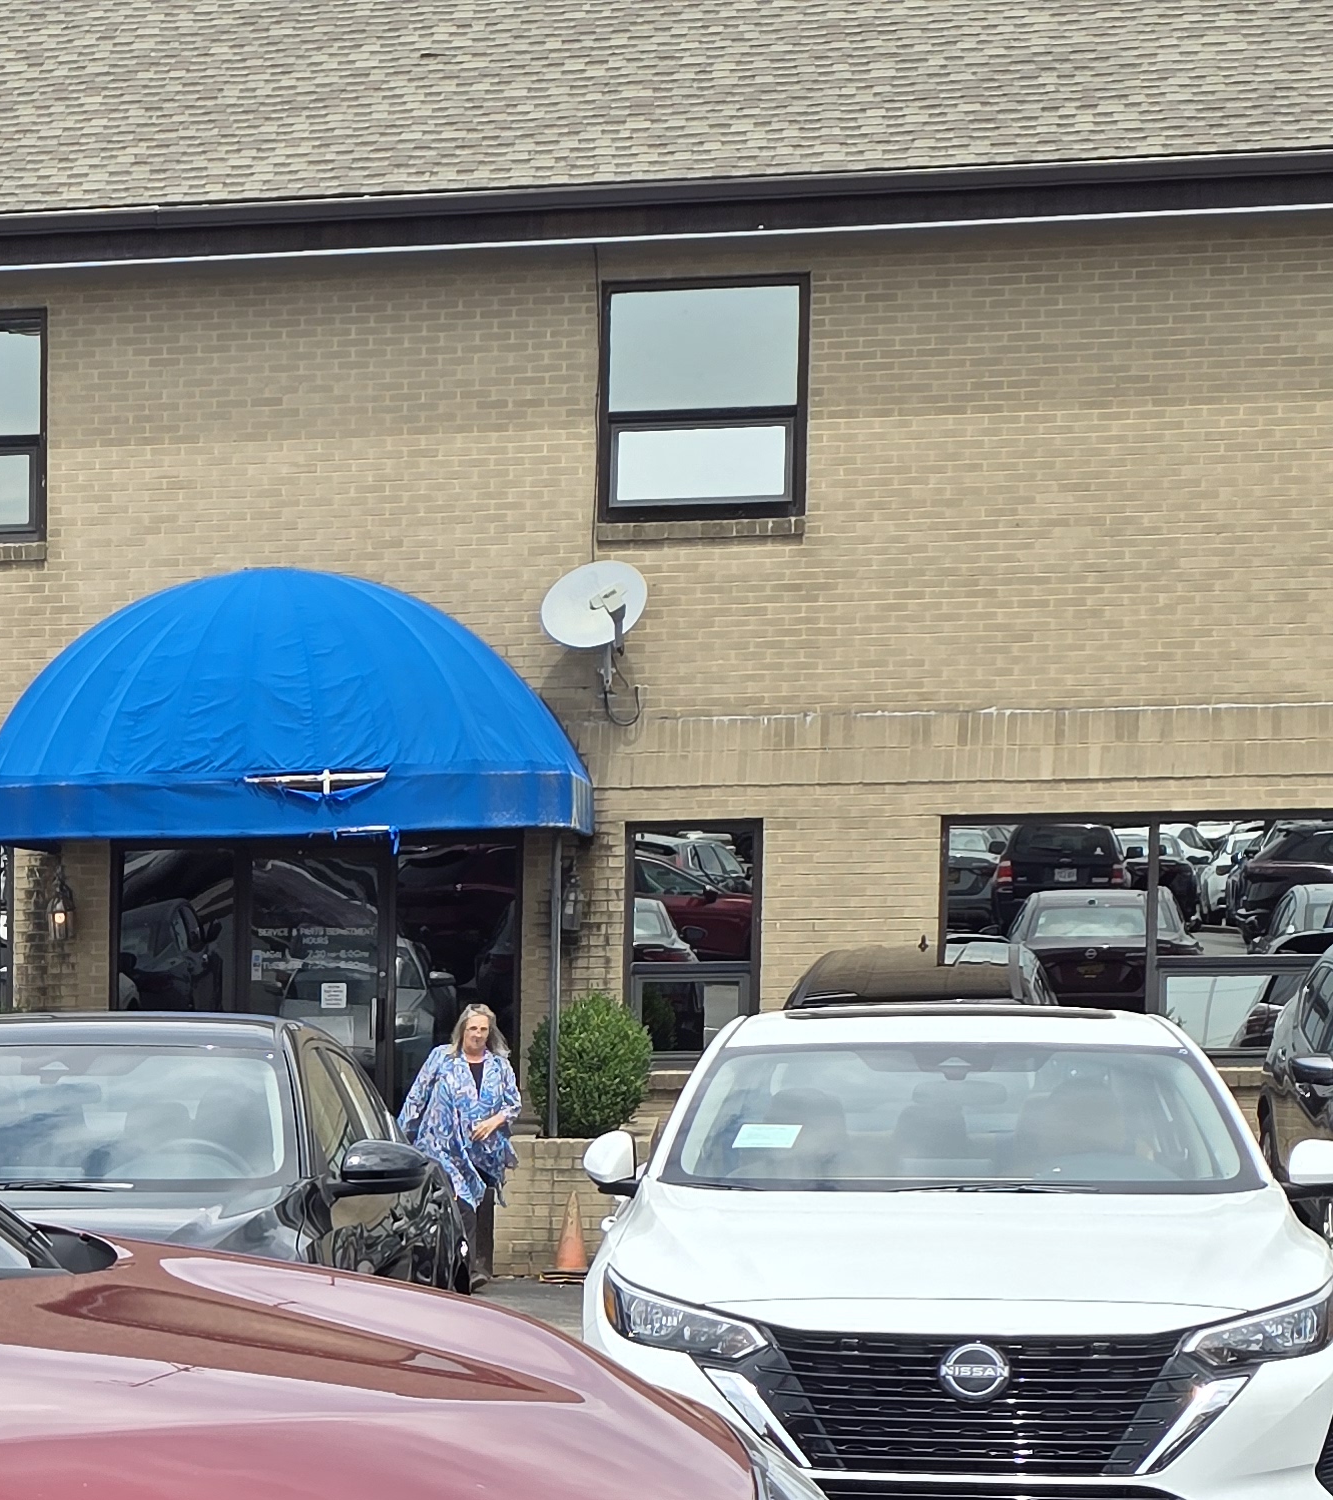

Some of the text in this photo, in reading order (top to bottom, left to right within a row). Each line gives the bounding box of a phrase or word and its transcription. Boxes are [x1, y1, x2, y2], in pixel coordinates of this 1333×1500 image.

[257, 927, 289, 937] SERVICE
[302, 936, 329, 945] HOURS
[939, 1365, 1010, 1377] NISSAN
